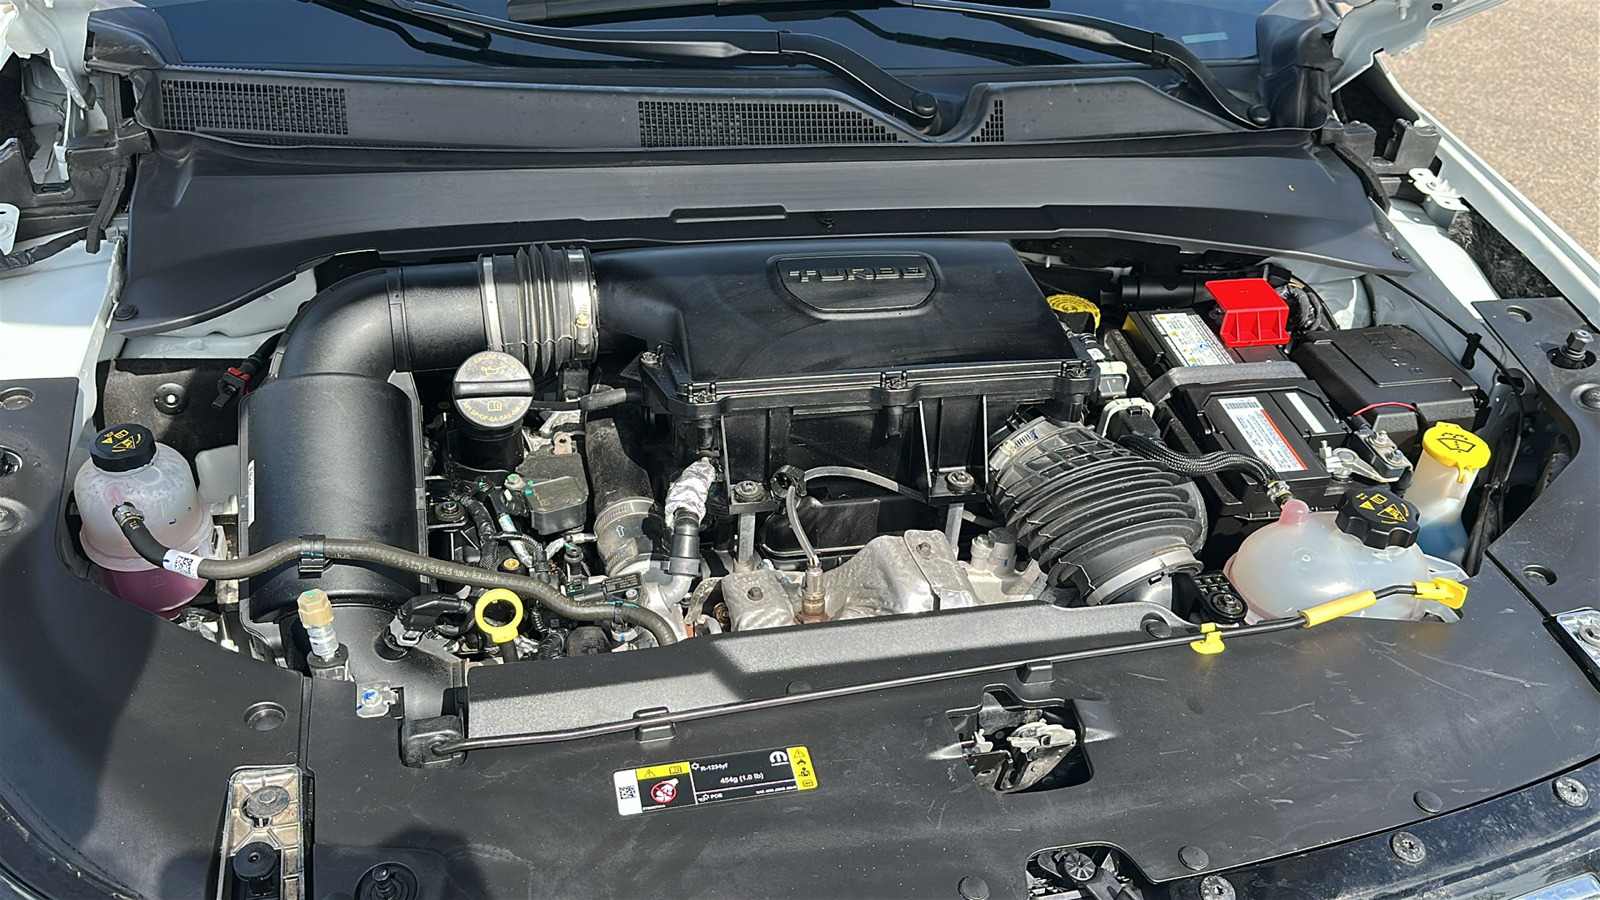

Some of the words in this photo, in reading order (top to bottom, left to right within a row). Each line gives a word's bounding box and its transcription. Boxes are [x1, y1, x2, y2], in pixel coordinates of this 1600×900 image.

[788, 266, 928, 283] TURBO
[700, 762, 729, 771] R-1234yf
[720, 776, 739, 784] 454g
[739, 774, 753, 783] (1.0
[753, 772, 764, 780] lb)
